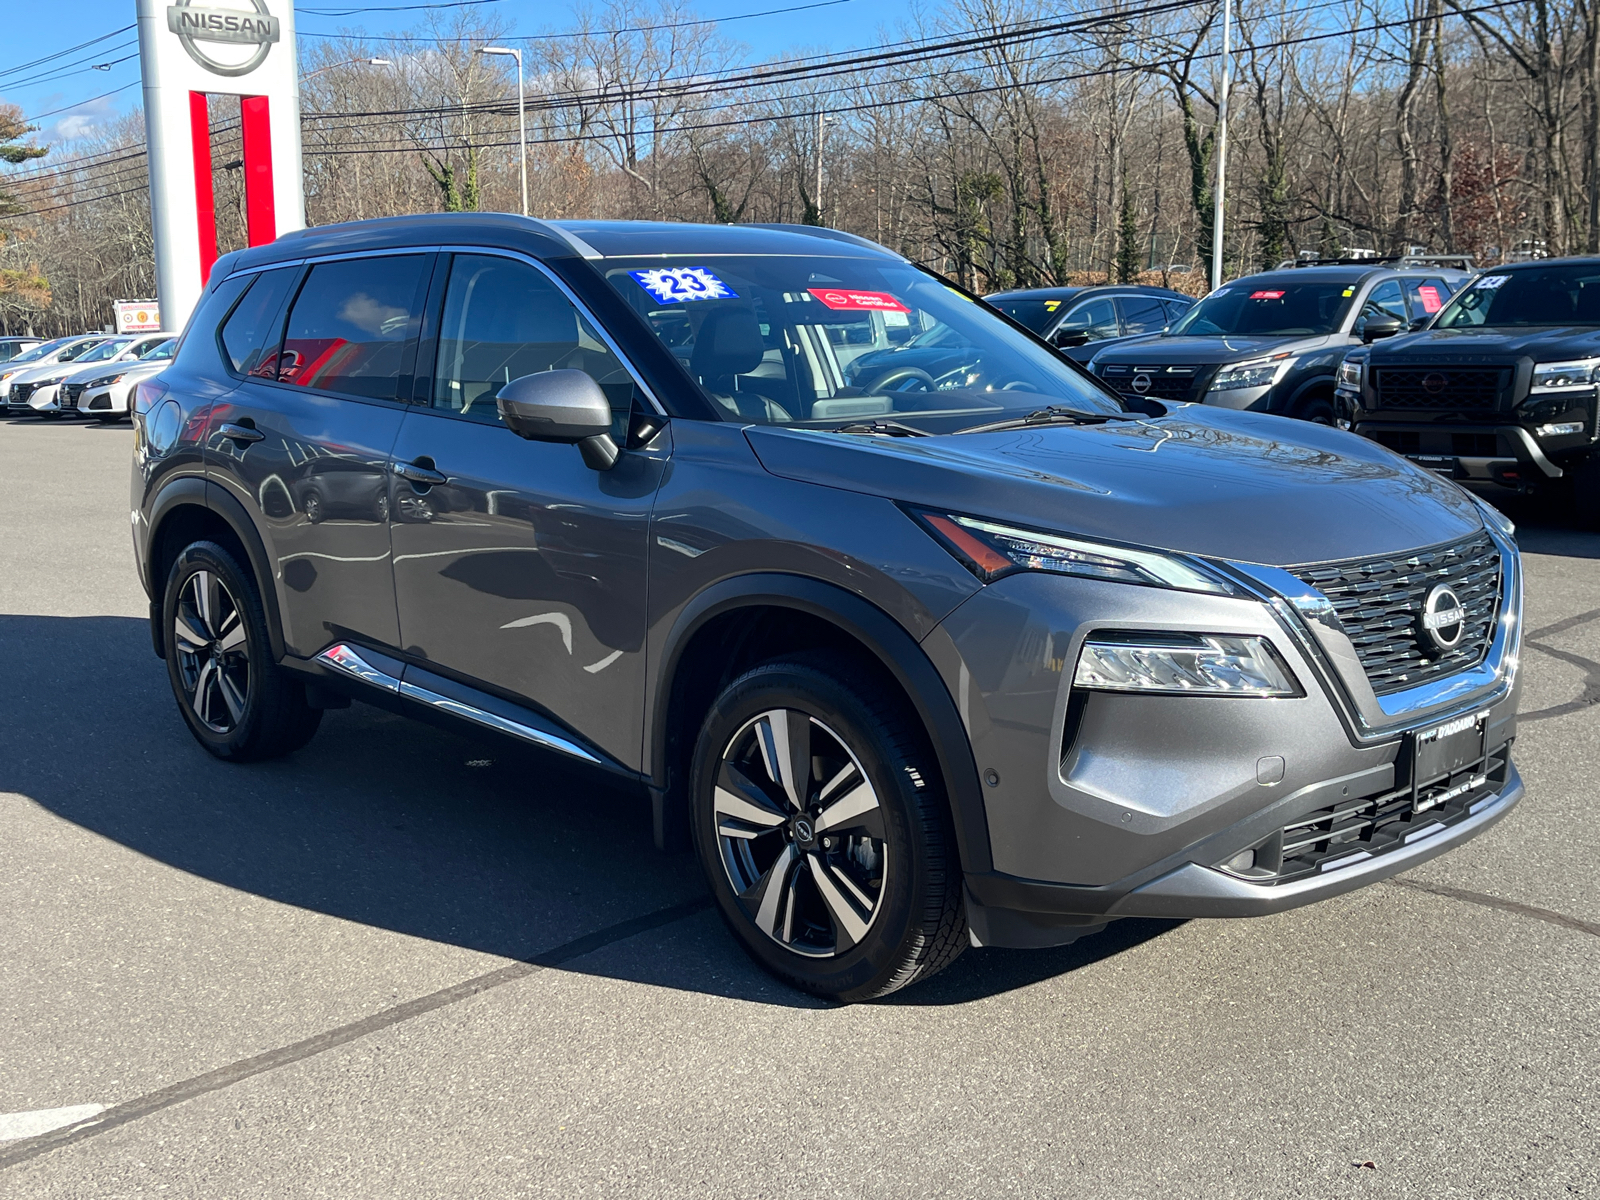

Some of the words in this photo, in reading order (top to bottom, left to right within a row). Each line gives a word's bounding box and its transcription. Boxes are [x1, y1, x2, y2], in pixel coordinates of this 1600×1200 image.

[181, 12, 271, 36] NISSAN
[660, 273, 707, 294] 23
[848, 294, 883, 302] Nissan
[855, 299, 898, 308] Certified
[1425, 607, 1465, 628] NISSAN
[1438, 715, 1476, 739] D'ADDARIO
